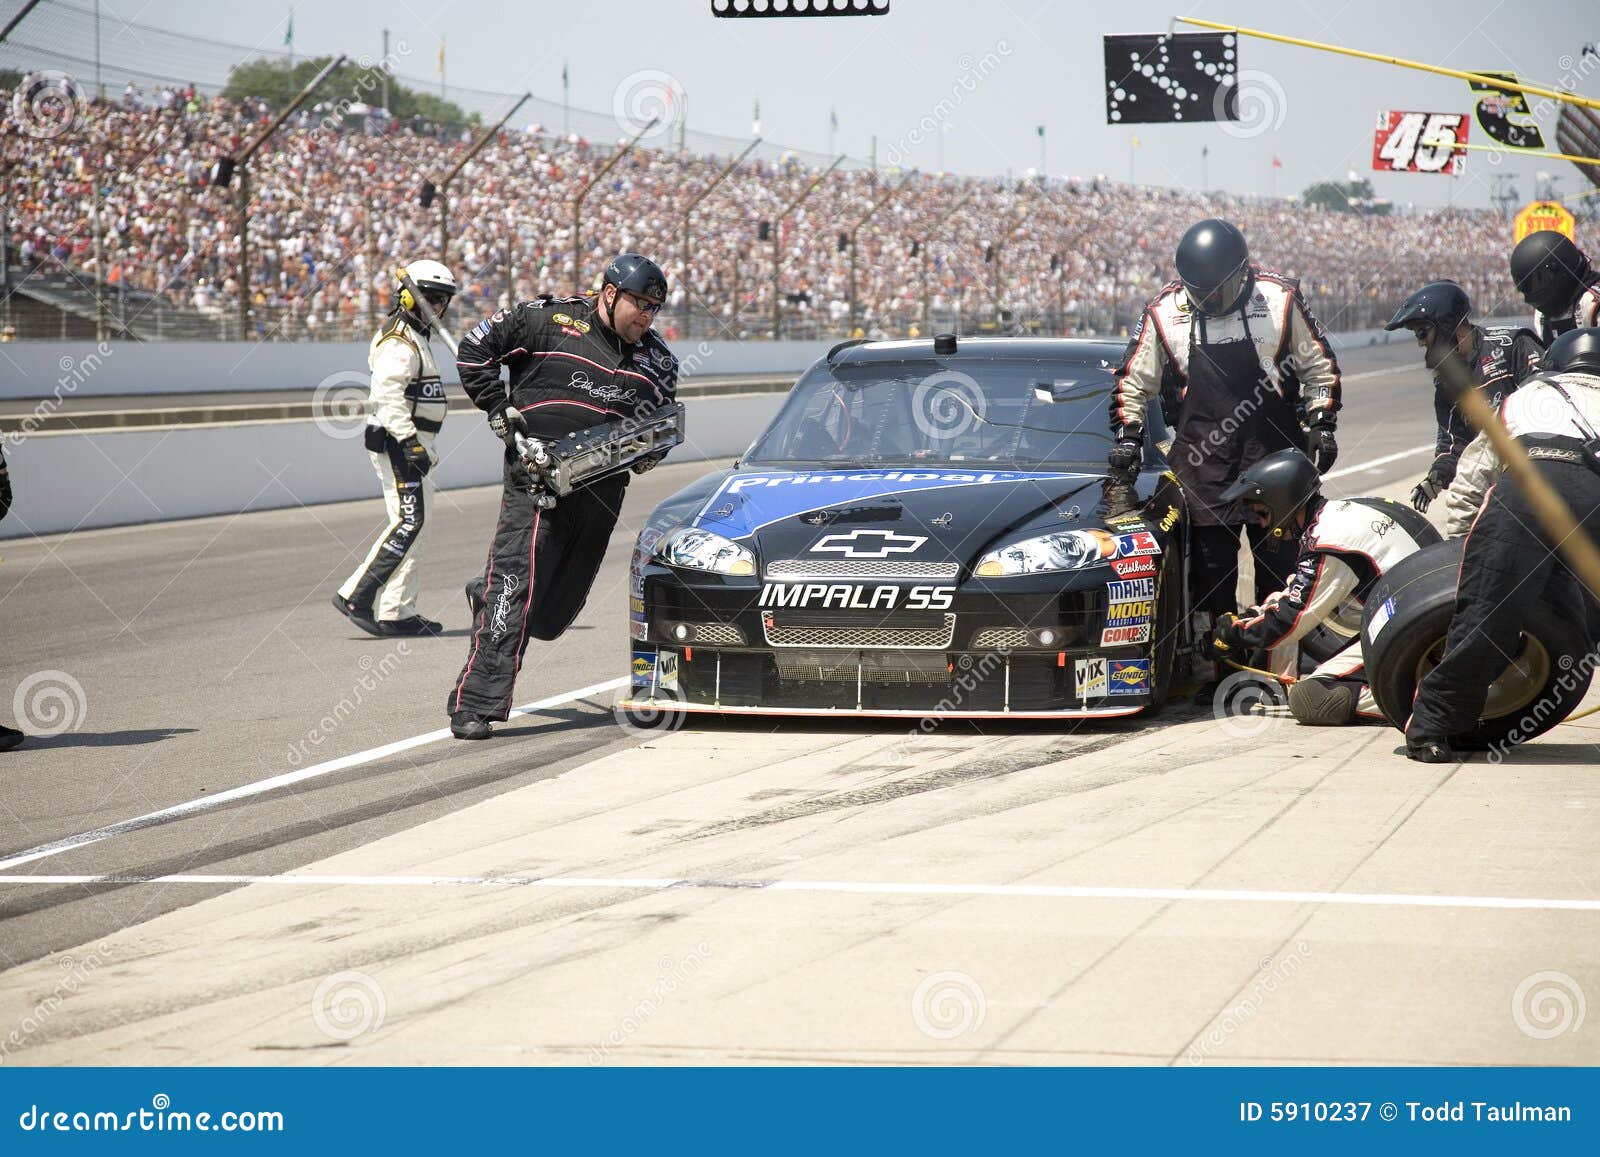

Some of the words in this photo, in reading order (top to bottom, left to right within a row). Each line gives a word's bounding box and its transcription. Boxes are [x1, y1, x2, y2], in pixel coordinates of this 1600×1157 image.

[1378, 112, 1462, 171] 45
[727, 471, 997, 493] Principal
[396, 494, 418, 538] Sprint
[1119, 532, 1156, 556] JE
[1116, 560, 1156, 576] Edelbrock
[758, 583, 900, 609] IMPALA
[905, 586, 957, 610] SS
[1108, 578, 1154, 600] MAHLE
[1107, 601, 1152, 620] MOOG
[1103, 627, 1140, 643] COMP
[1076, 660, 1105, 685] WIX
